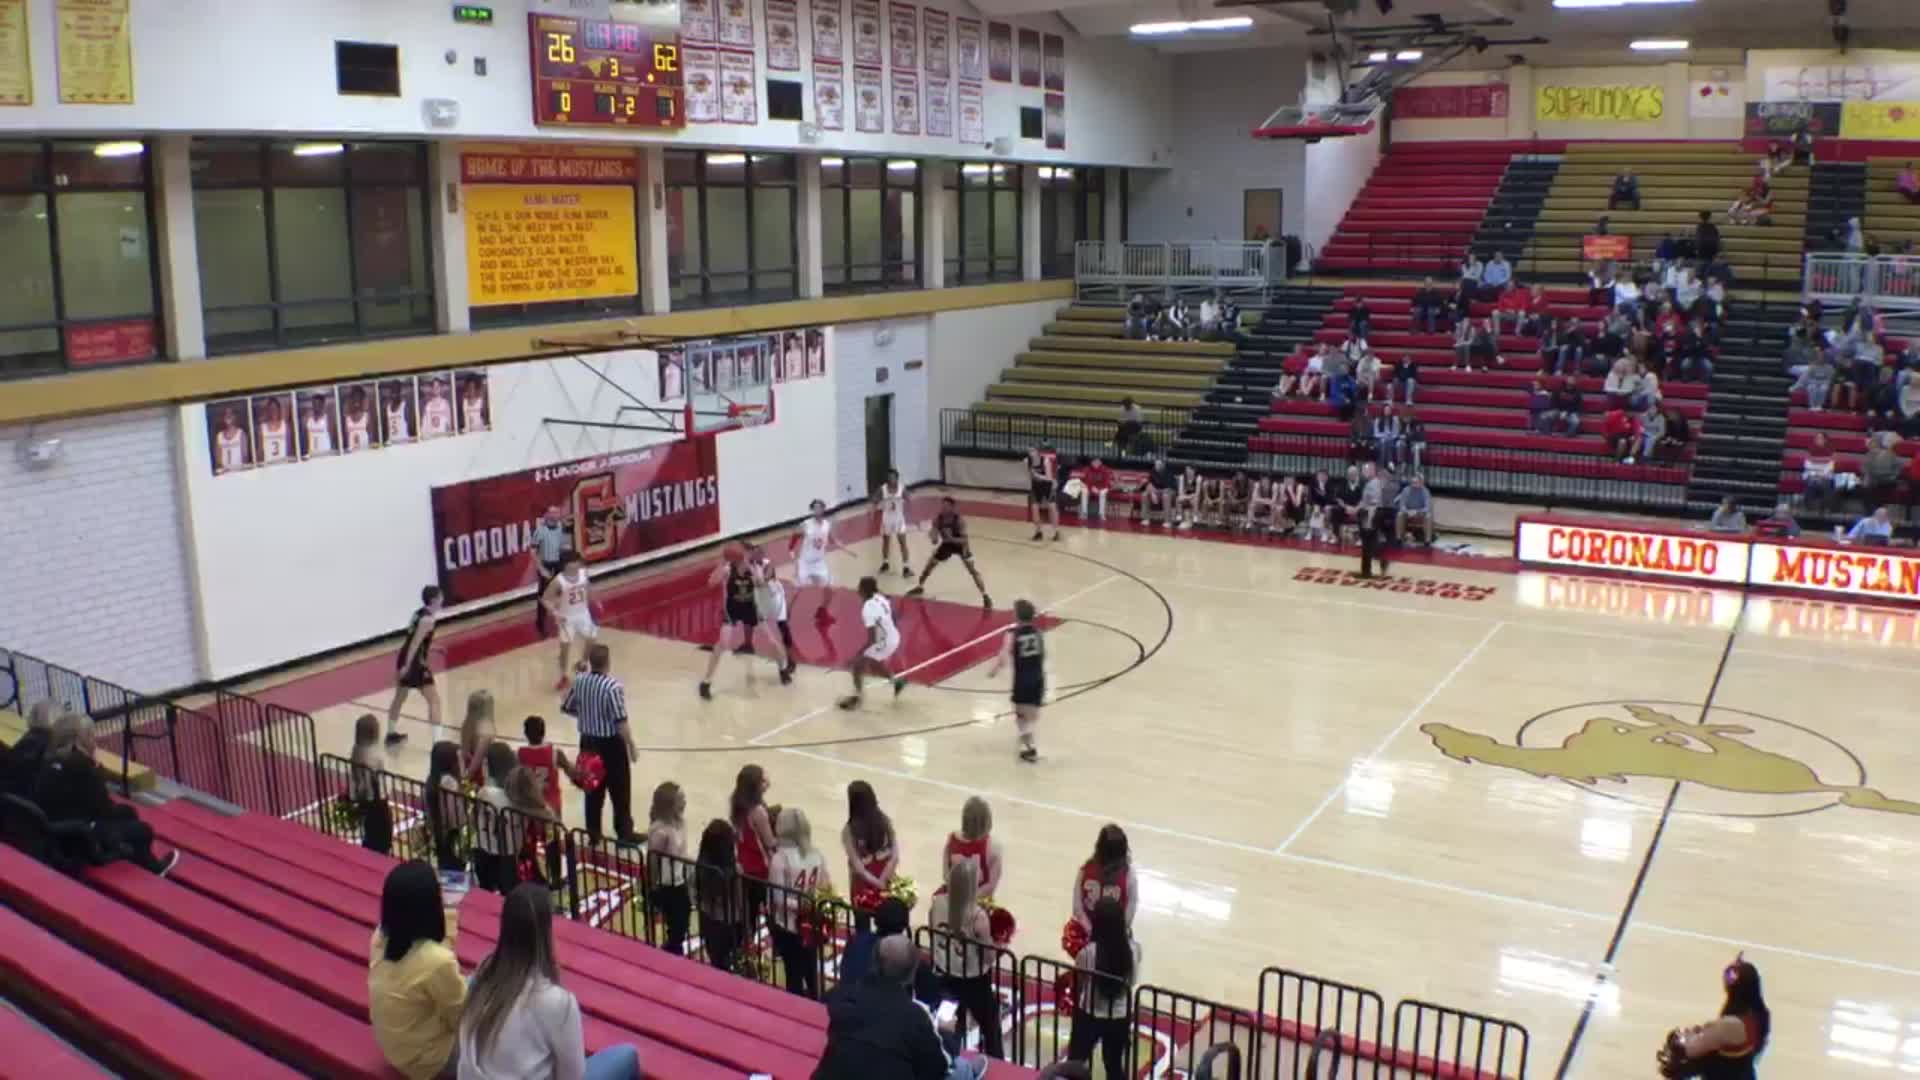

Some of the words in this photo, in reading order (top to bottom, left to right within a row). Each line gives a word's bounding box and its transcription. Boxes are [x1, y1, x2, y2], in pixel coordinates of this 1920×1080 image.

[547, 33, 575, 63] 26
[653, 43, 678, 72] 62
[609, 58, 619, 77] 3
[560, 92, 571, 112] 0
[466, 158, 505, 176] HOME
[511, 159, 527, 176] OF
[530, 159, 556, 176] THE
[559, 159, 623, 177] MUSTANGS
[625, 475, 717, 523] MUSTANGS
[1547, 528, 1719, 575] CORONADO
